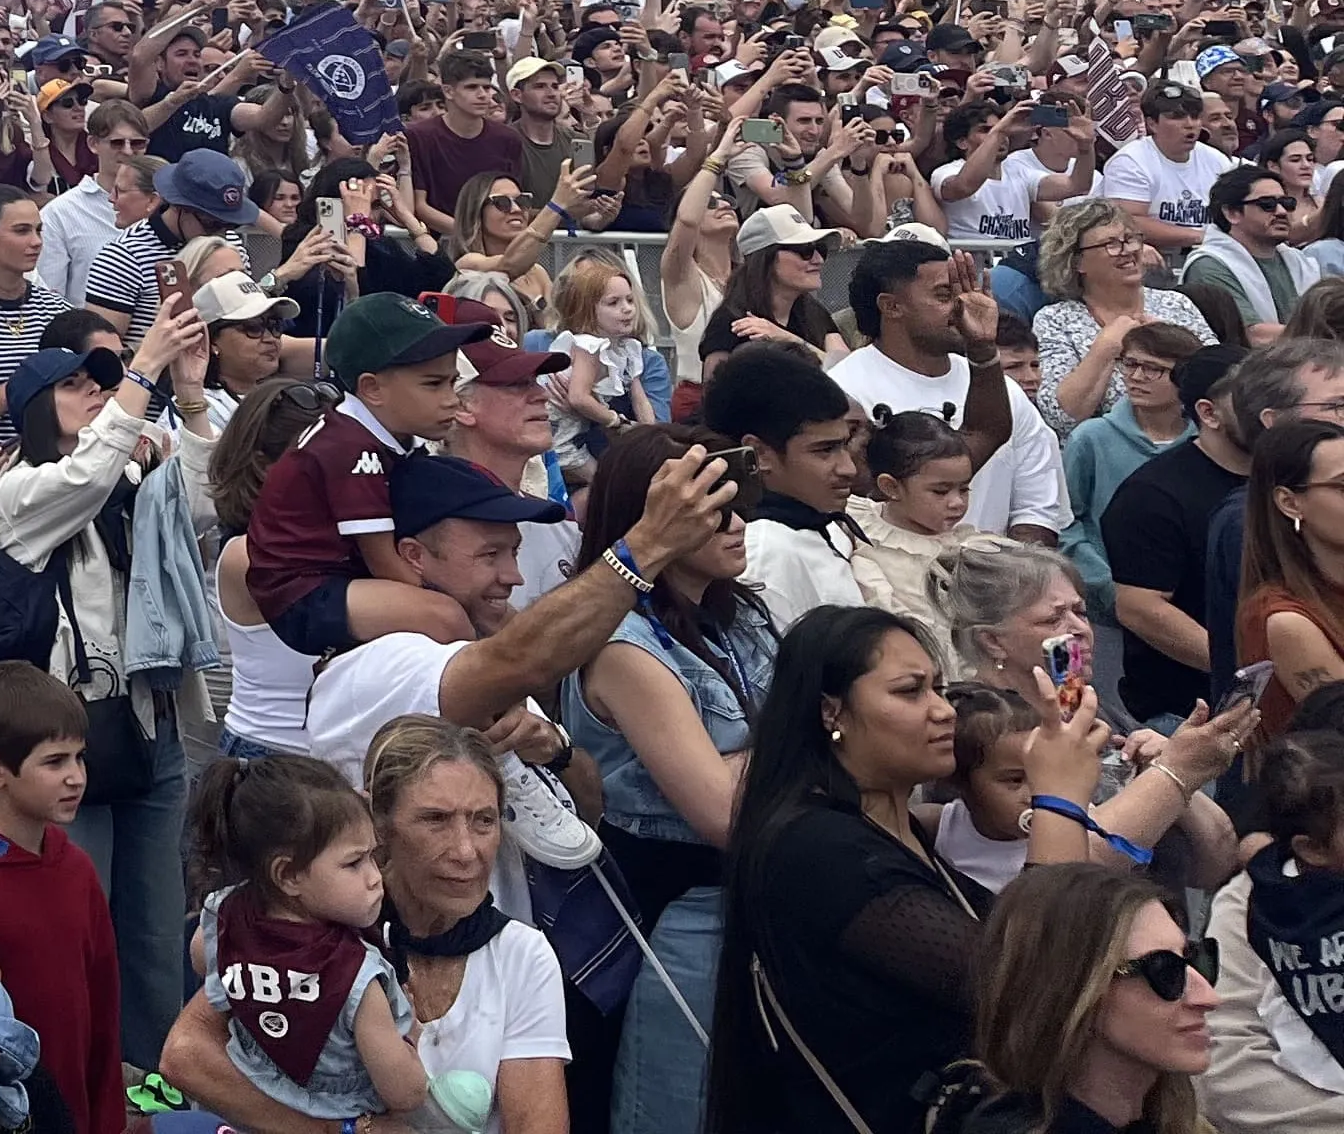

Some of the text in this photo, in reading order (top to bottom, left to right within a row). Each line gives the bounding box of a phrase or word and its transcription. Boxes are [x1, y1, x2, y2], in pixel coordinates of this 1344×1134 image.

[1159, 201, 1212, 224] CHAMPION
[1268, 931, 1344, 972] WE AR
[221, 962, 320, 1003] UBB
[1293, 973, 1344, 1016] UB
